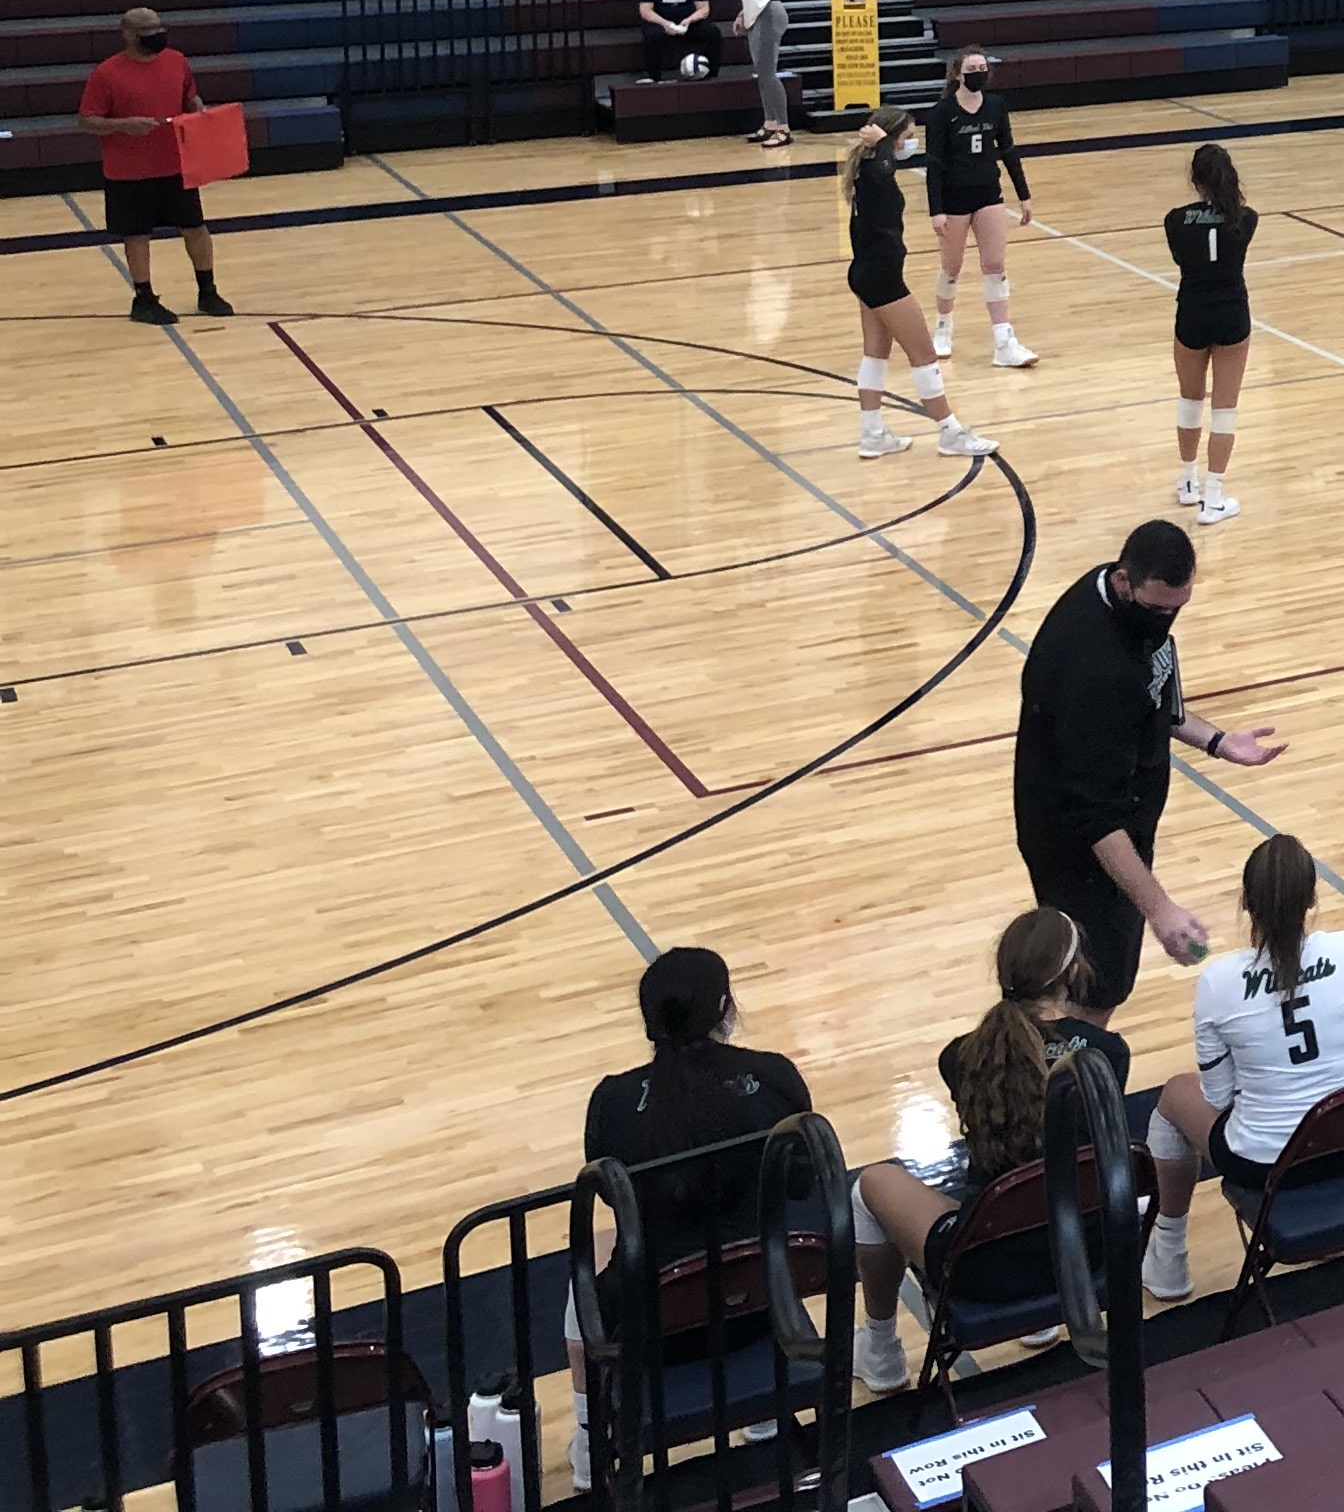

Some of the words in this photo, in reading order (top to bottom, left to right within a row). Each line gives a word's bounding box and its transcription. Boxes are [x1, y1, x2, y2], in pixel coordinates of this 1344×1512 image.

[835, 15, 876, 28] PLEASE
[971, 134, 982, 153] 6
[1208, 228, 1217, 262] 1
[1281, 995, 1319, 1065] 5
[989, 1438, 1007, 1448] In
[1010, 1430, 1035, 1442] Sit
[952, 1446, 985, 1459] this
[1236, 1442, 1264, 1456] Sit
[1212, 1452, 1233, 1463] In
[909, 1459, 948, 1475] Row
[1169, 1460, 1207, 1476] this
[917, 1472, 951, 1487] Not
